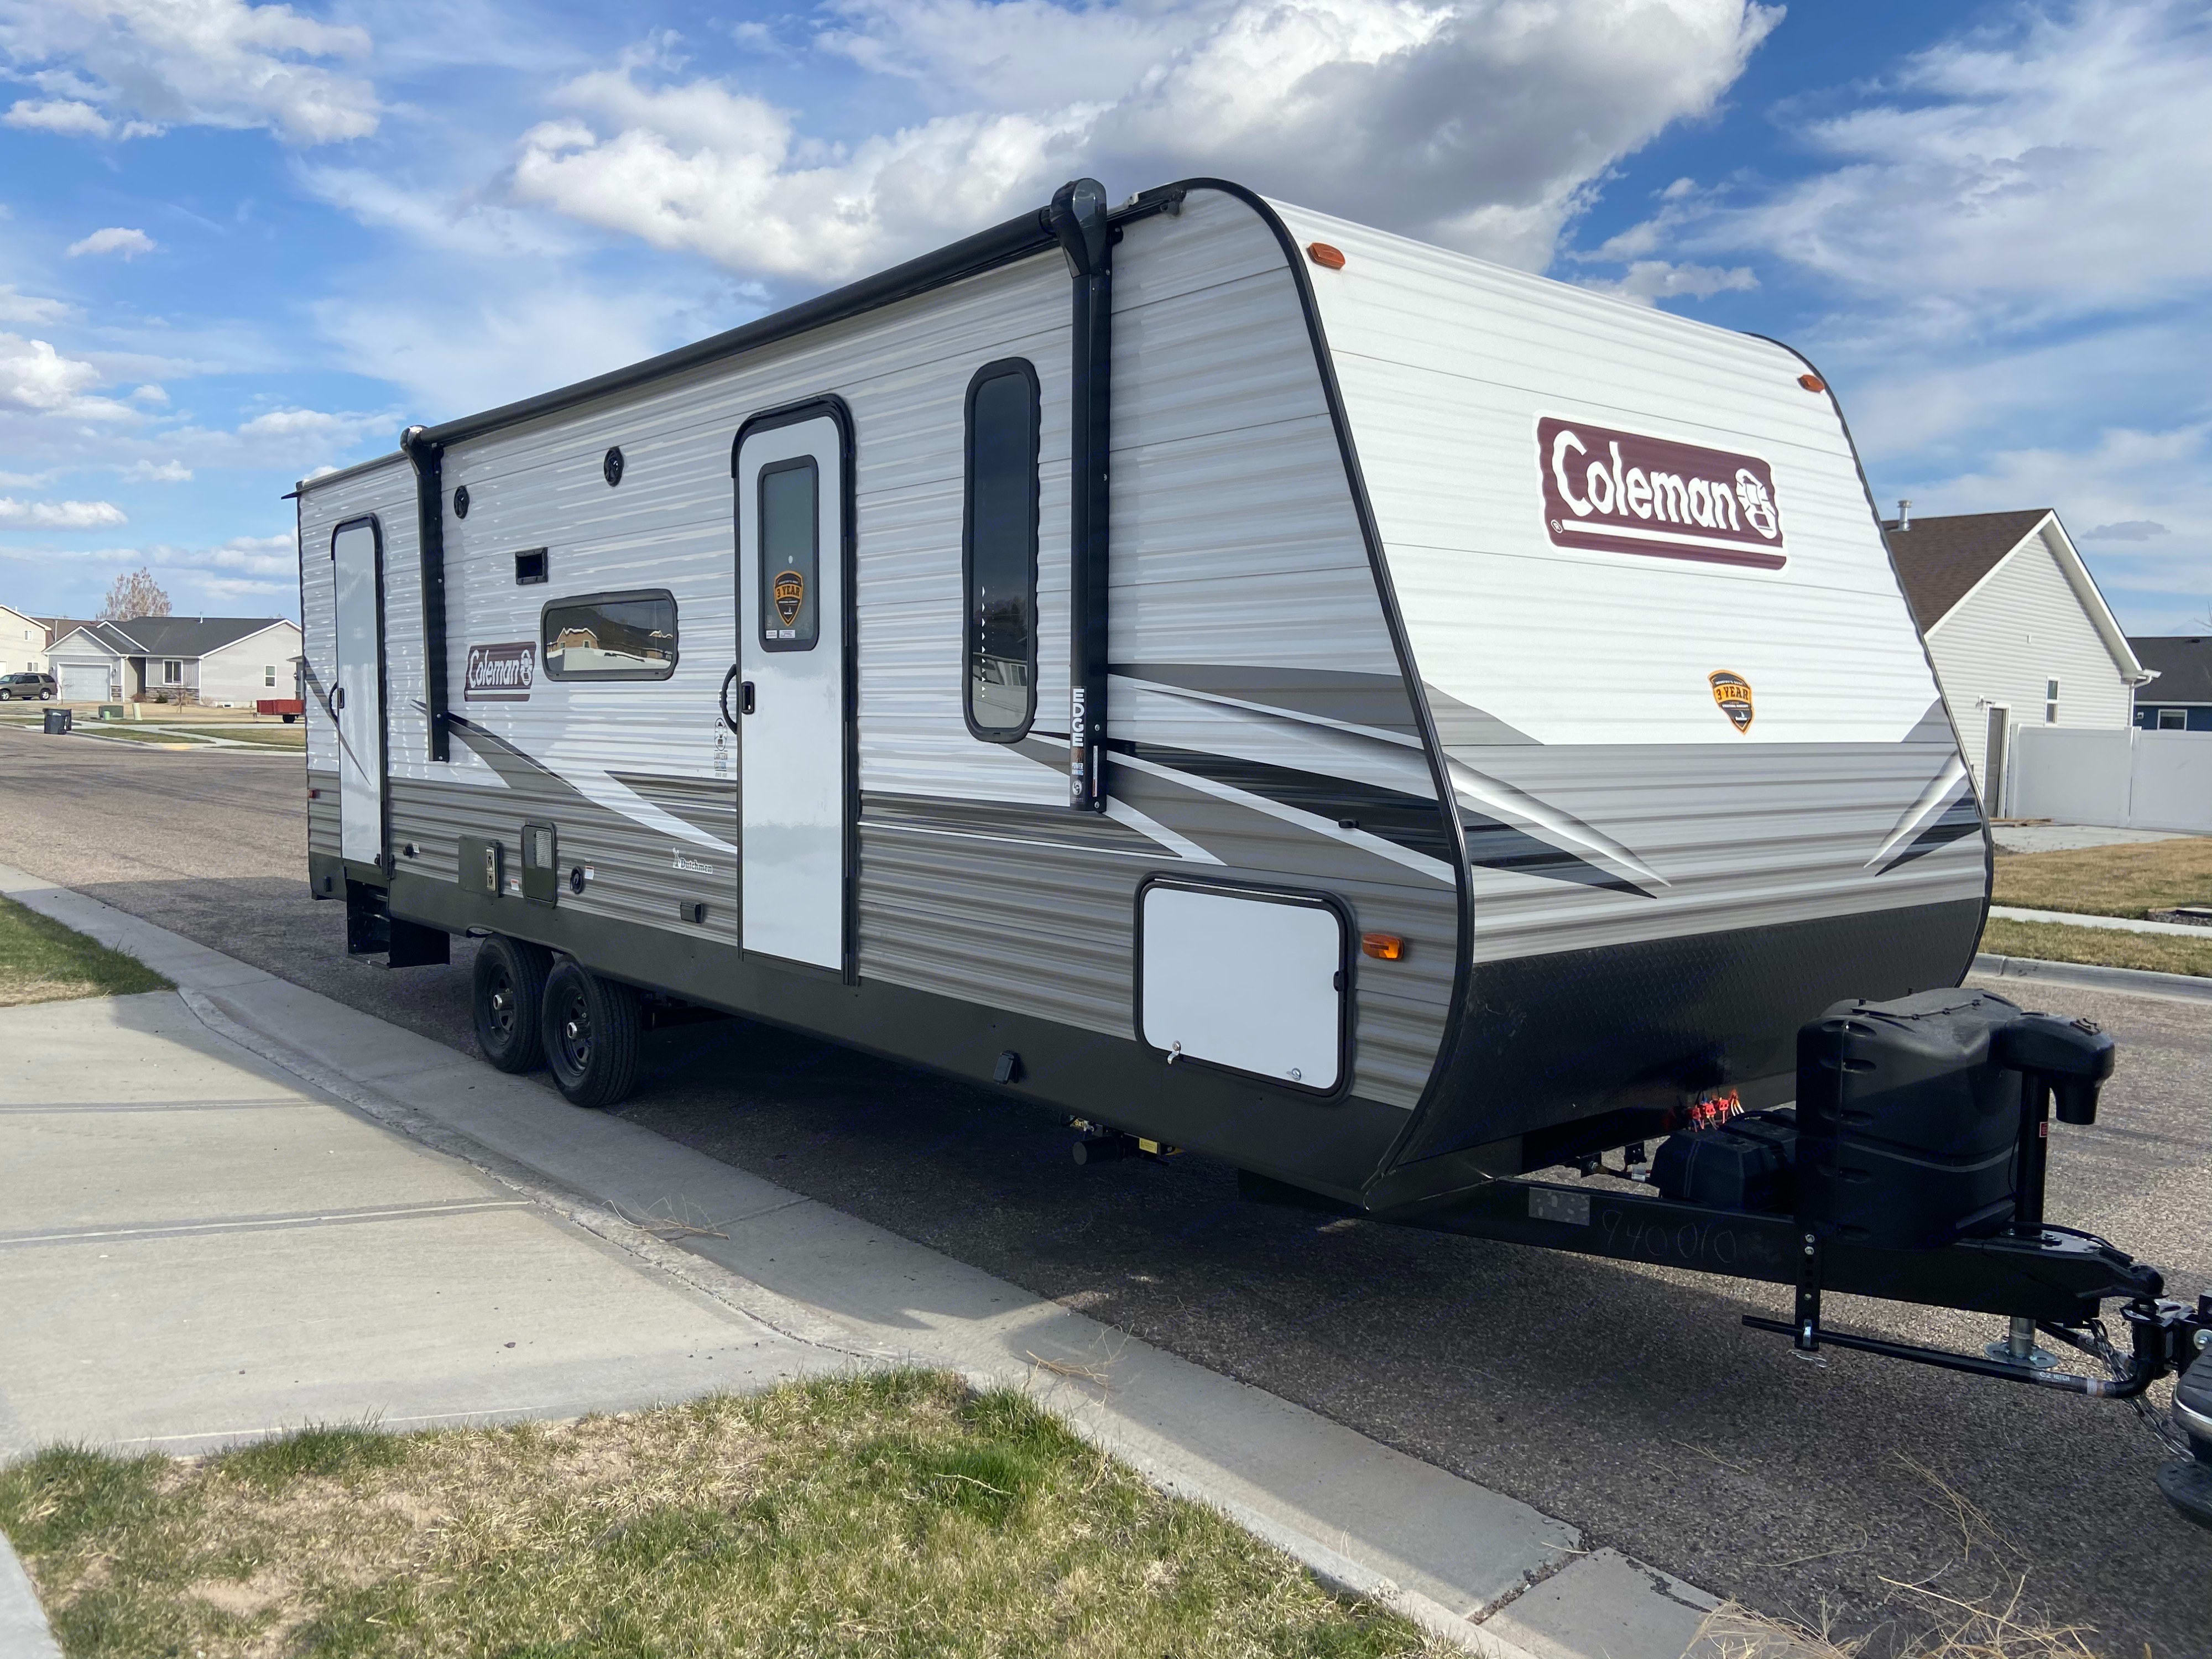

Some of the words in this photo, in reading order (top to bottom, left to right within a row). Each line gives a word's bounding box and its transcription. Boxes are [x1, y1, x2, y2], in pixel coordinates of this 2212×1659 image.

[1552, 430, 1740, 531] Coleman
[777, 588, 781, 598] 3
[782, 586, 800, 597] YEAR
[469, 649, 519, 688] Coleman
[1716, 688, 1722, 700] 3
[1723, 686, 1748, 700] YEAR
[1072, 688, 1084, 747] EDGE
[680, 858, 712, 873] Dutchmen
